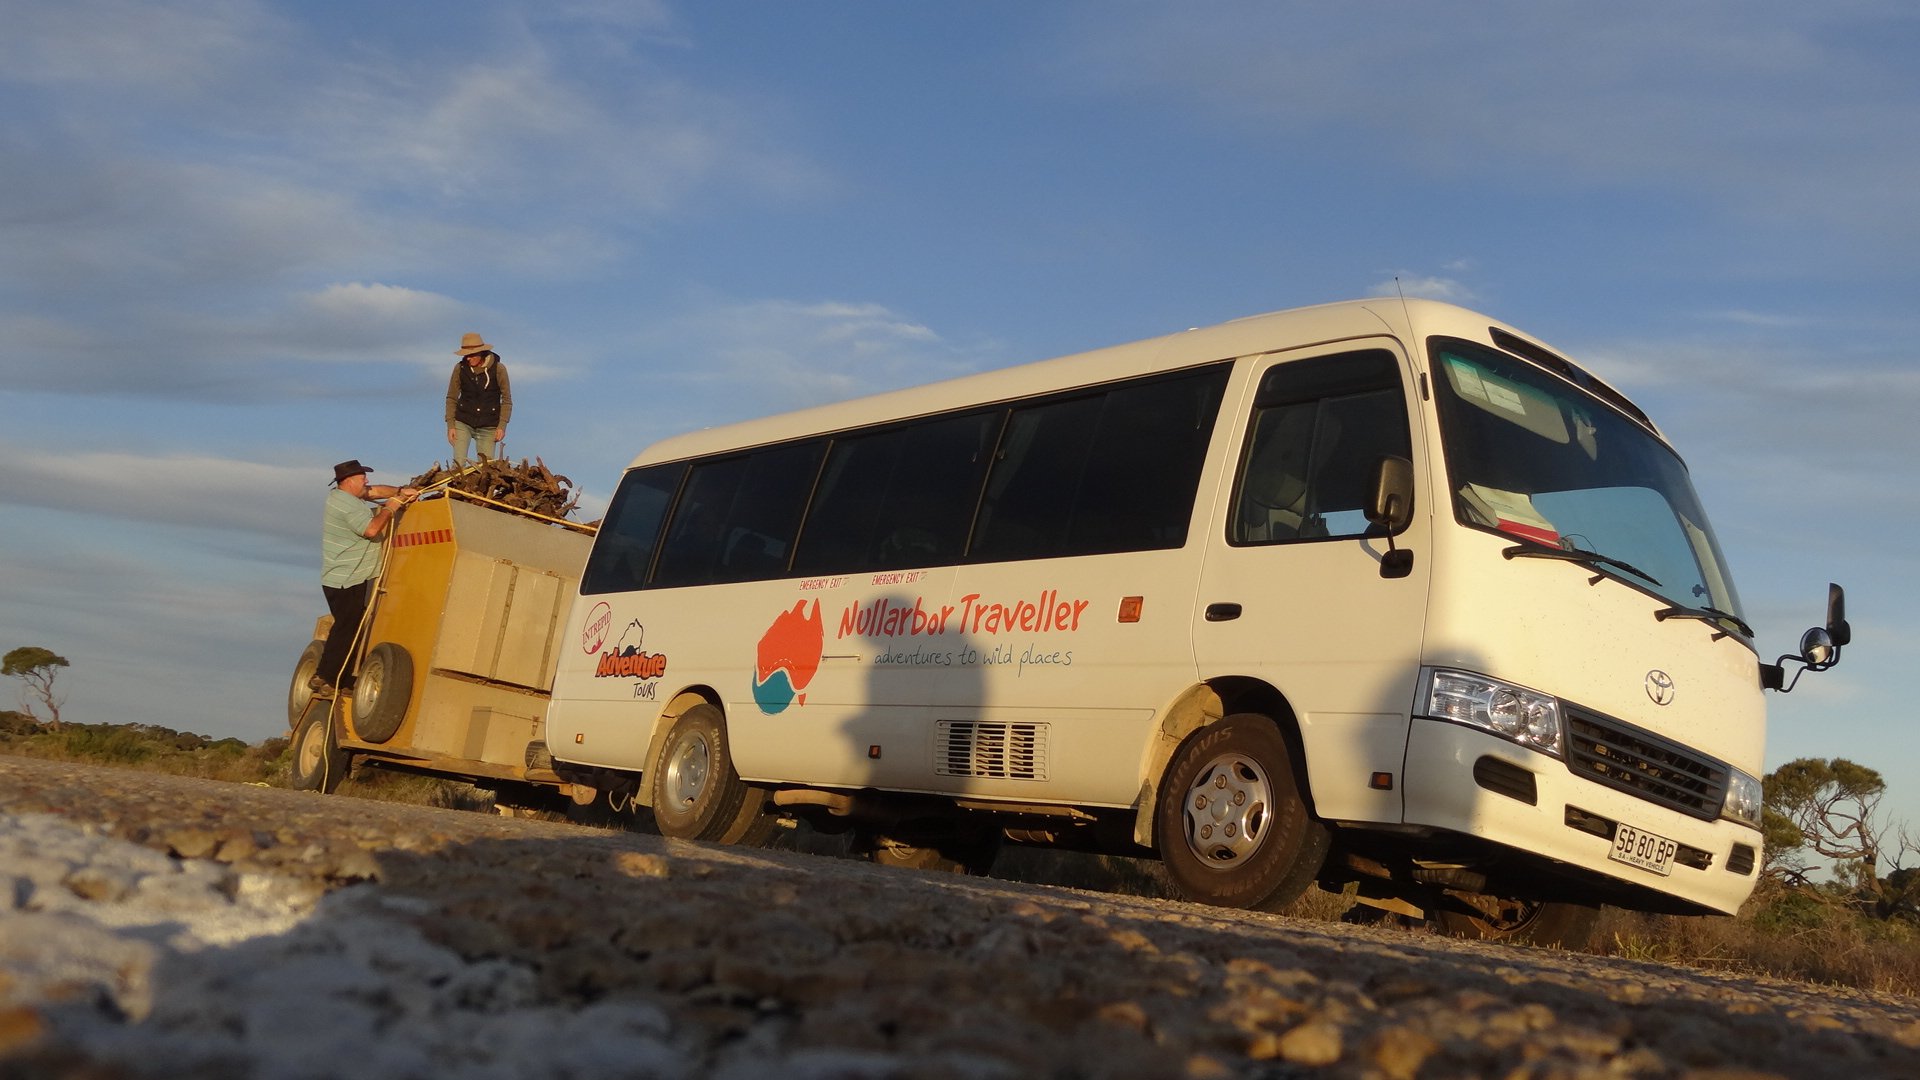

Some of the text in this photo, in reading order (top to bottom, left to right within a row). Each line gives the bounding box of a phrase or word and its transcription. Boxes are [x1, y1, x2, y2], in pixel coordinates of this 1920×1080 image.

[799, 578, 843, 590] EMERGENCY EXIT
[872, 571, 920, 585] EMERGENCY EXIT
[583, 610, 612, 645] INTREPID
[838, 589, 1089, 639] Nullarbor Traveller
[595, 646, 667, 680] Adventure
[874, 642, 1072, 678] adventures to wild places
[1630, 856, 1644, 864] HEAVY
[1645, 861, 1664, 871] VEHICLE
